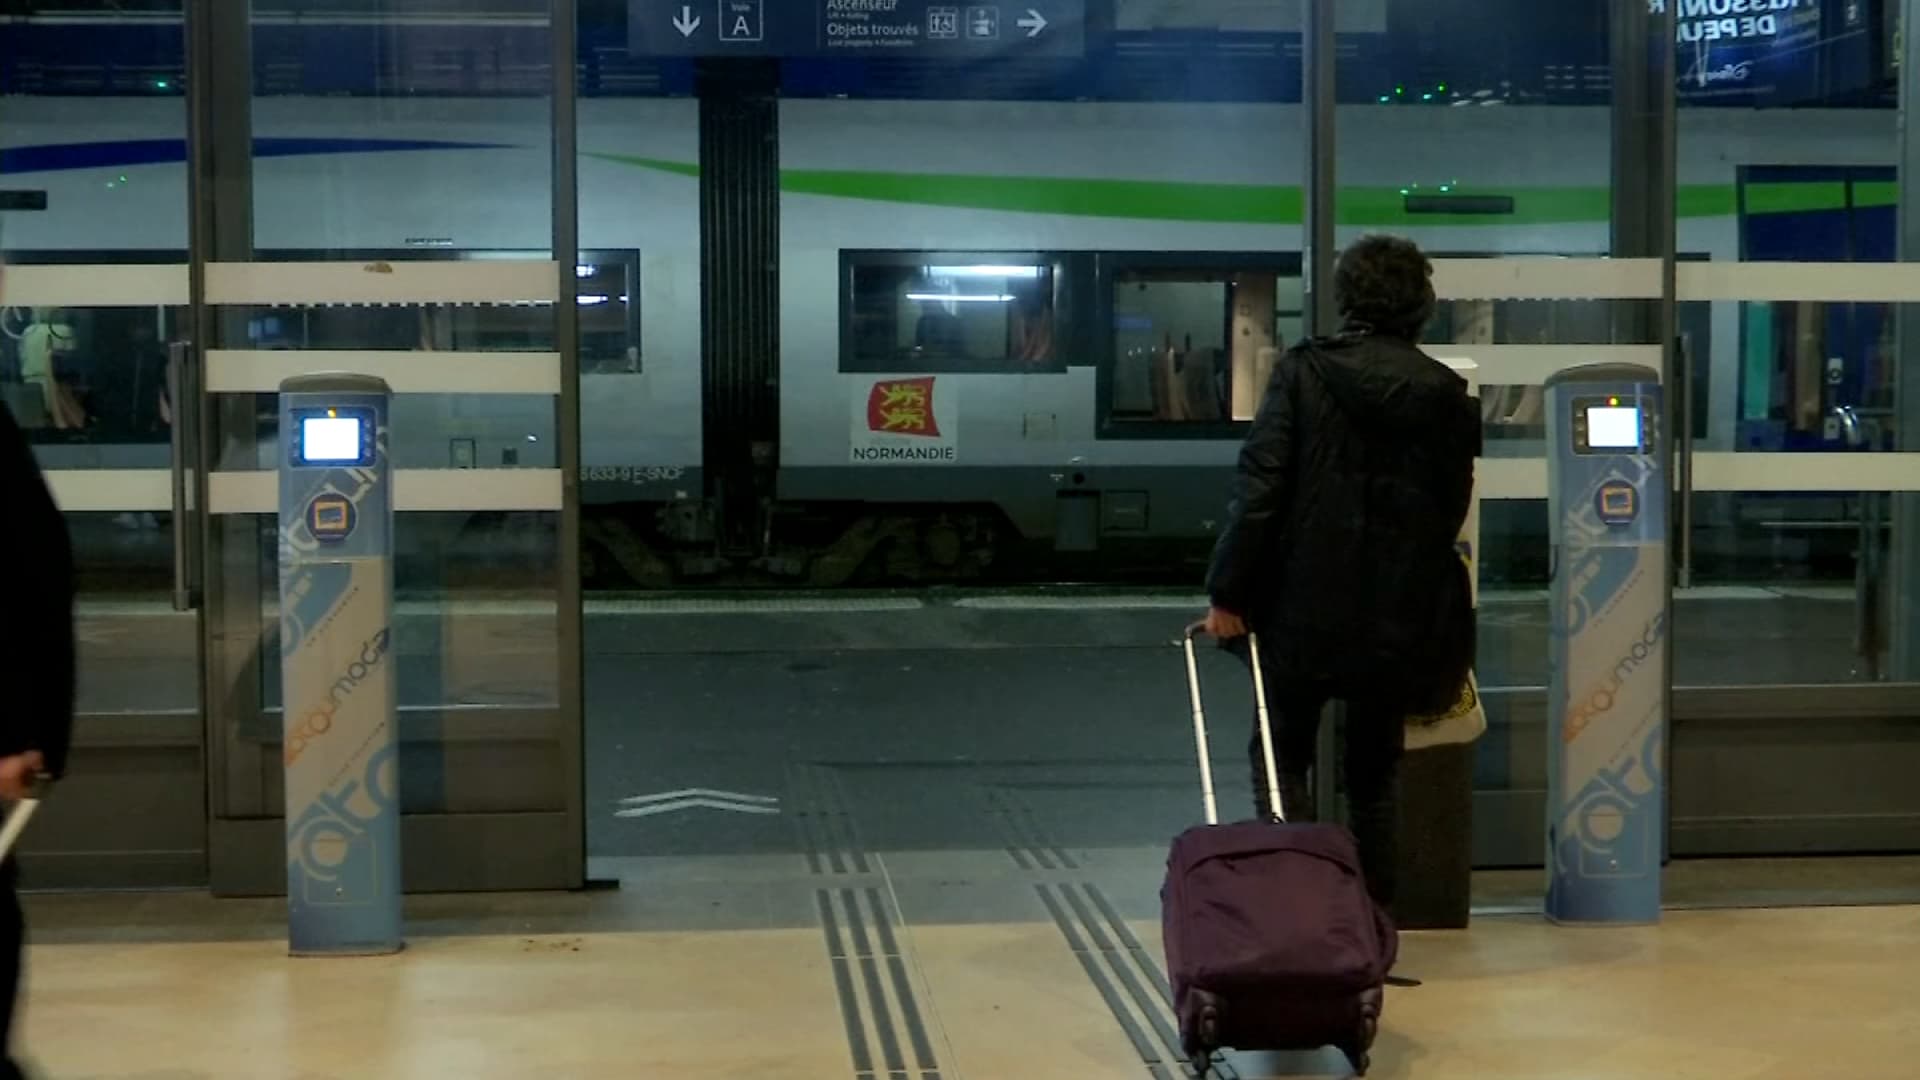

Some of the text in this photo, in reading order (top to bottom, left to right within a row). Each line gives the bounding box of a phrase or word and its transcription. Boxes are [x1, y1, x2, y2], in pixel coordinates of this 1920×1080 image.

[732, 15, 750, 36] A
[827, 22, 919, 38] Objets trouvés
[853, 447, 953, 460] NORMANDIE
